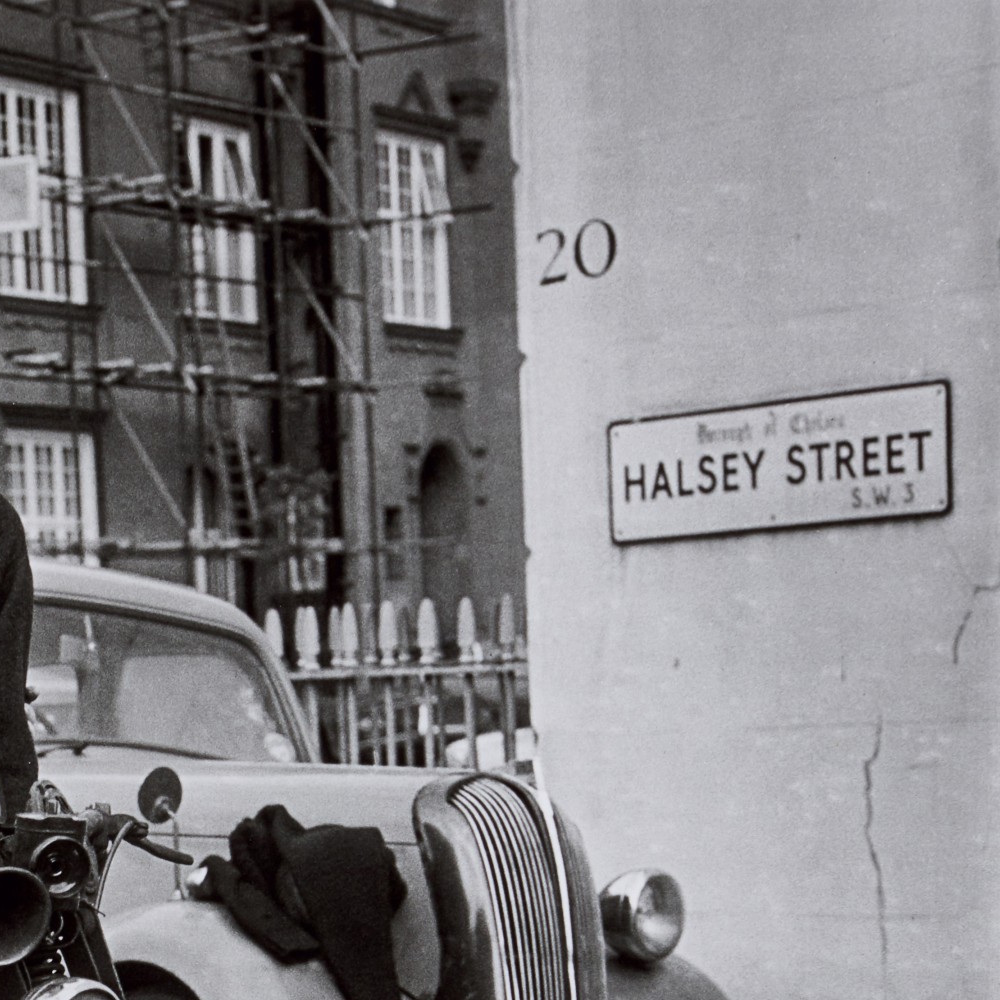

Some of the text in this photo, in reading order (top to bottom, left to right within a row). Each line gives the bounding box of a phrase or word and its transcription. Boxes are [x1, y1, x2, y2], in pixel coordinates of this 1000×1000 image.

[536, 218, 618, 286] 20
[623, 430, 933, 503] HALSEY STREET
